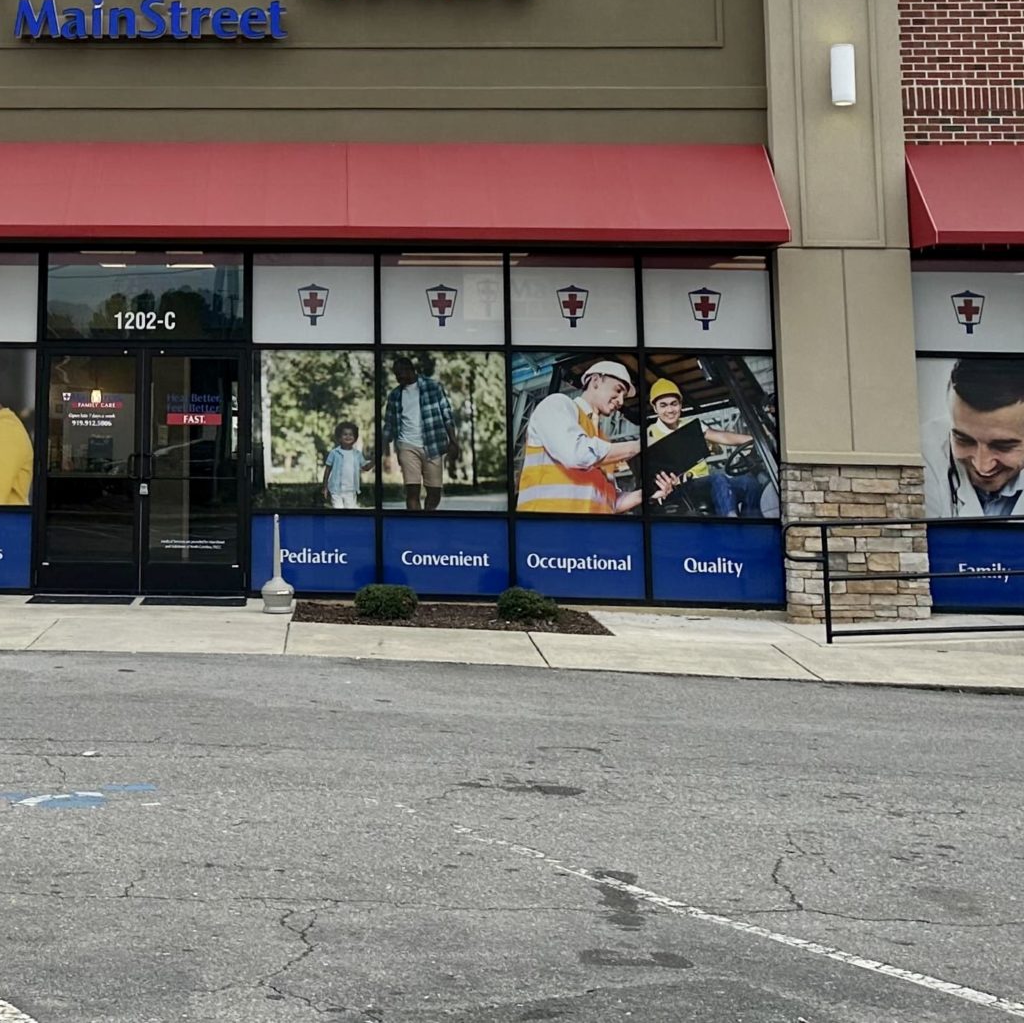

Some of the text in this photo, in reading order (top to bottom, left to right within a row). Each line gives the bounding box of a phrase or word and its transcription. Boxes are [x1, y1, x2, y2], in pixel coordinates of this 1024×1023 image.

[113, 311, 176, 330] 1202-C
[183, 414, 207, 424] FAST.
[279, 548, 348, 565] Pediatric
[401, 550, 490, 568] Convenient
[526, 553, 632, 574] Occupational
[683, 556, 744, 578] Quality
